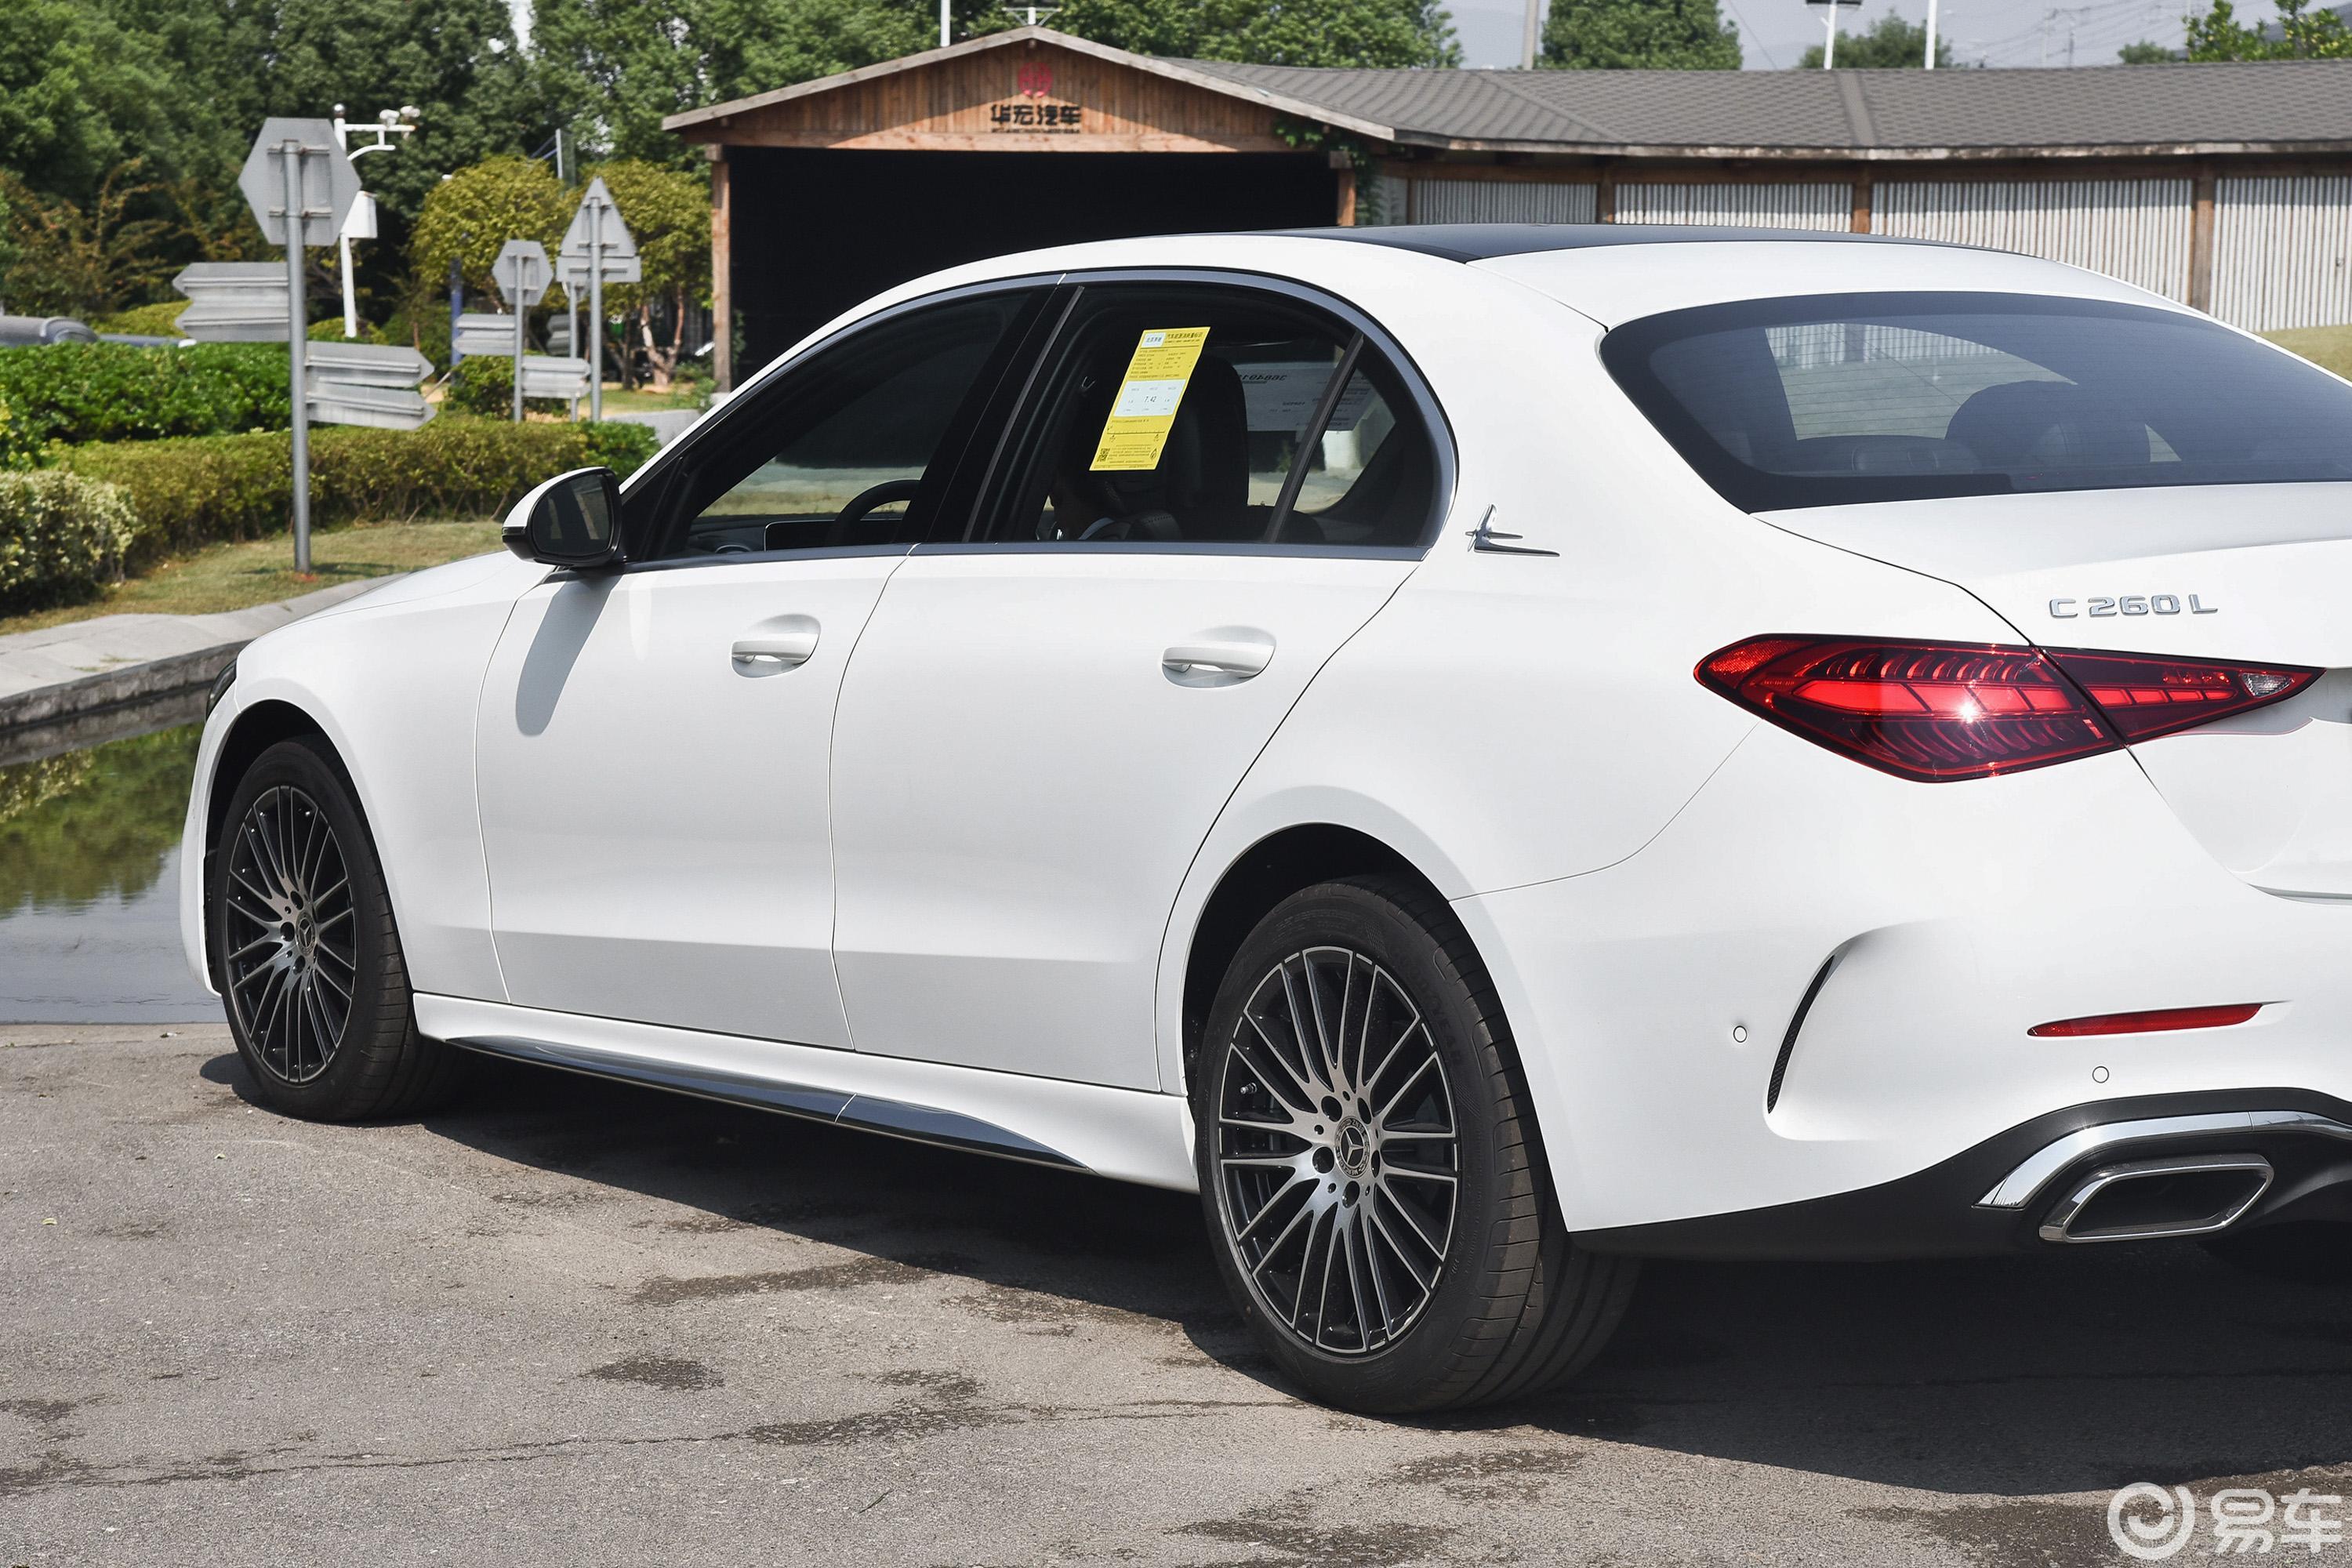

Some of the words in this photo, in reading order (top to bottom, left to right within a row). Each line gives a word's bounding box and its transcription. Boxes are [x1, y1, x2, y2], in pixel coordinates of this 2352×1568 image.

[991, 104, 1081, 125] 华宏汽车
[2049, 598, 2078, 619] C
[2088, 594, 2181, 617] 260
[2188, 593, 2219, 615] L
